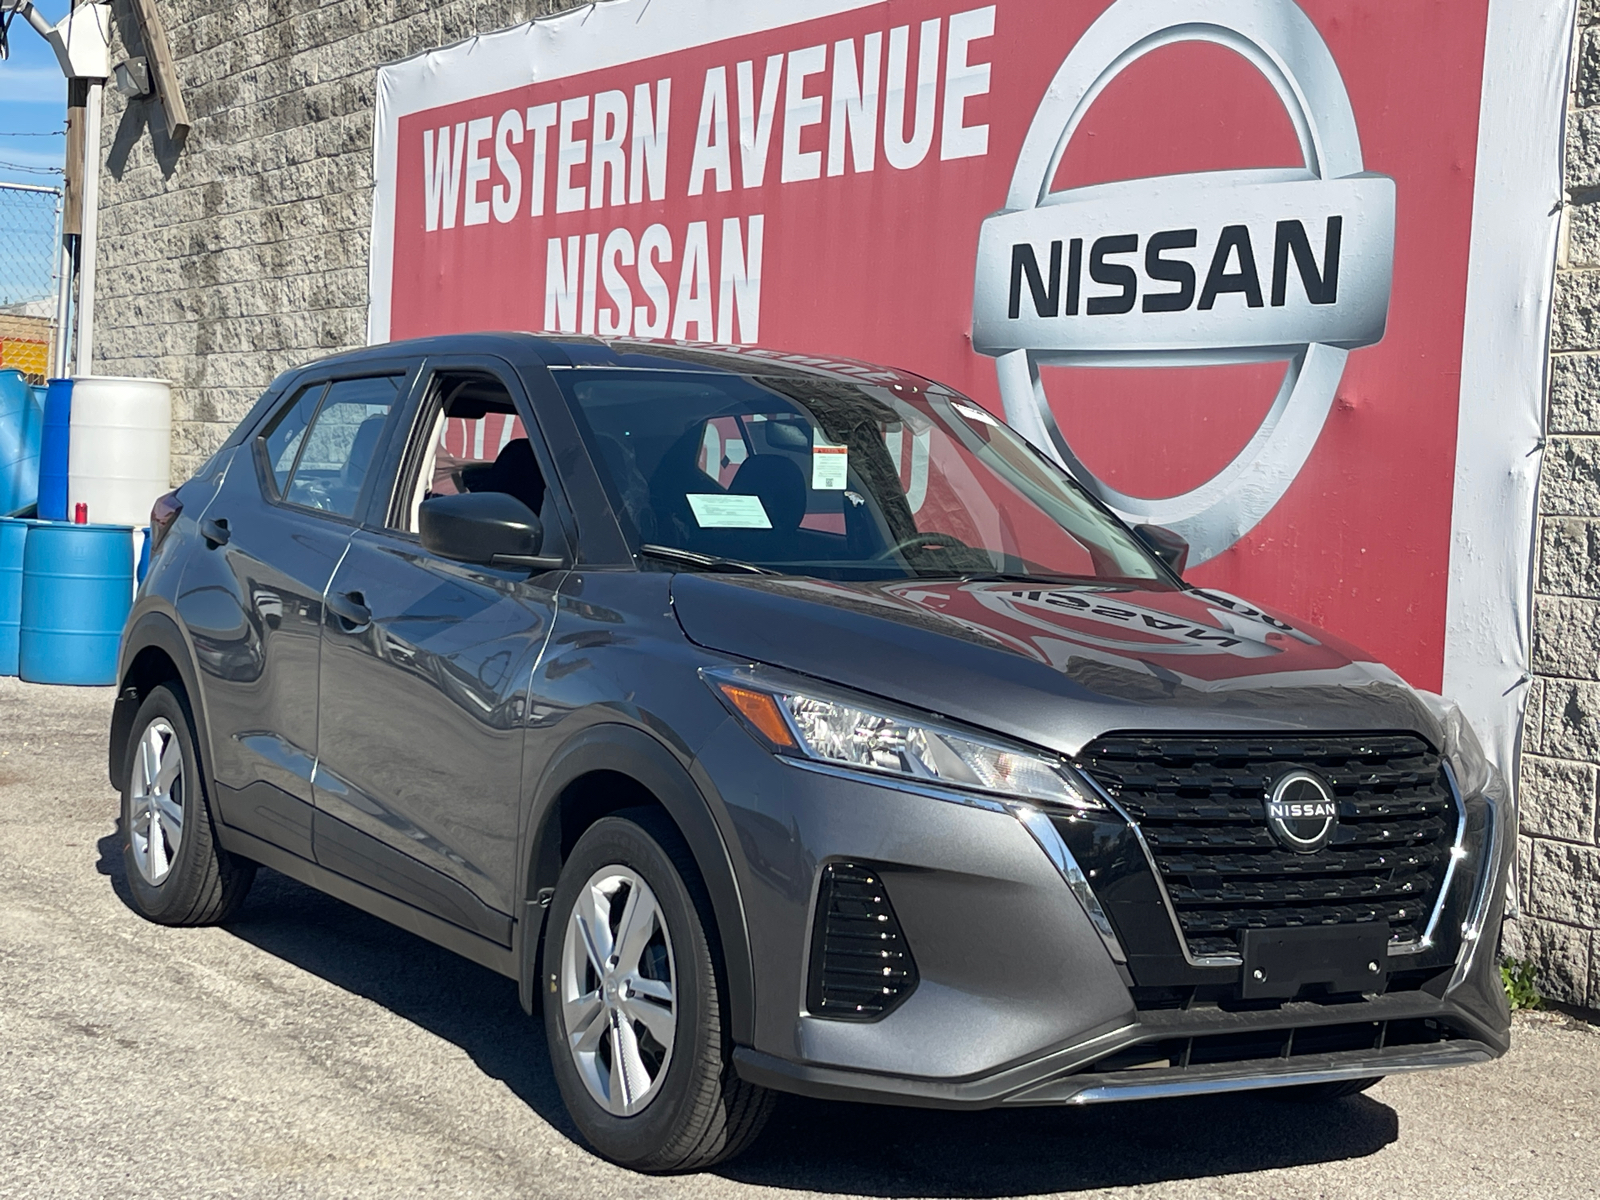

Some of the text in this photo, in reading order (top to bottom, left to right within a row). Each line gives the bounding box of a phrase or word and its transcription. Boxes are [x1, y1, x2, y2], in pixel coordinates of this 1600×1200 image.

[423, 4, 997, 232] WESTERN AVENUE
[544, 214, 765, 344] NISSAN
[1008, 215, 1343, 319] NISSAN
[1270, 803, 1336, 817] NISSAN
